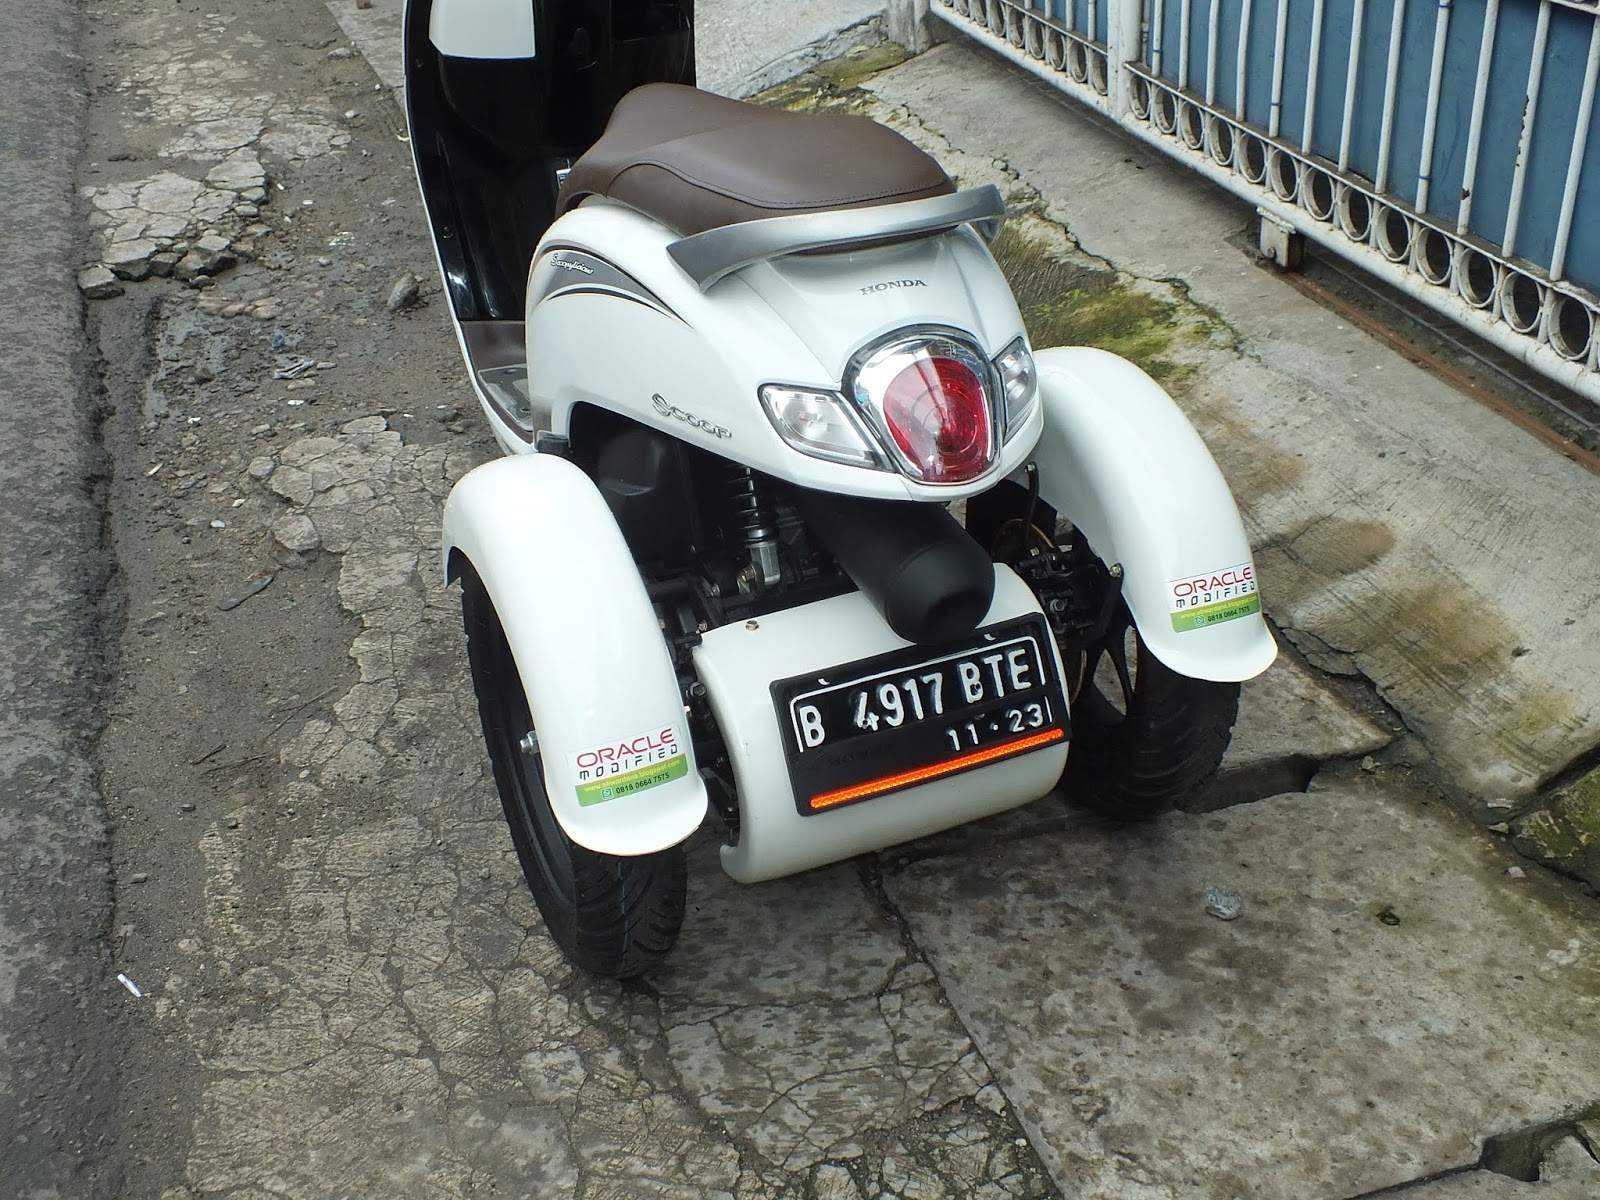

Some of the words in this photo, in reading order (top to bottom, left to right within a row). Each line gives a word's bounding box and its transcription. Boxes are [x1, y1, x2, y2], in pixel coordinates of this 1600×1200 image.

[860, 280, 928, 295] HONDA
[1174, 567, 1253, 597] ORACLE
[1176, 581, 1255, 608] MODIFIED
[1207, 611, 1223, 622] 0818
[1223, 608, 1238, 618] 0664
[800, 705, 825, 747] B
[856, 672, 944, 731] 4917
[958, 648, 1032, 704] BTE
[577, 728, 675, 768] ORACLE
[580, 743, 678, 780] MODIFIED
[615, 784, 634, 794] 0818
[634, 778, 652, 789] 0664
[653, 772, 670, 784] 7575
